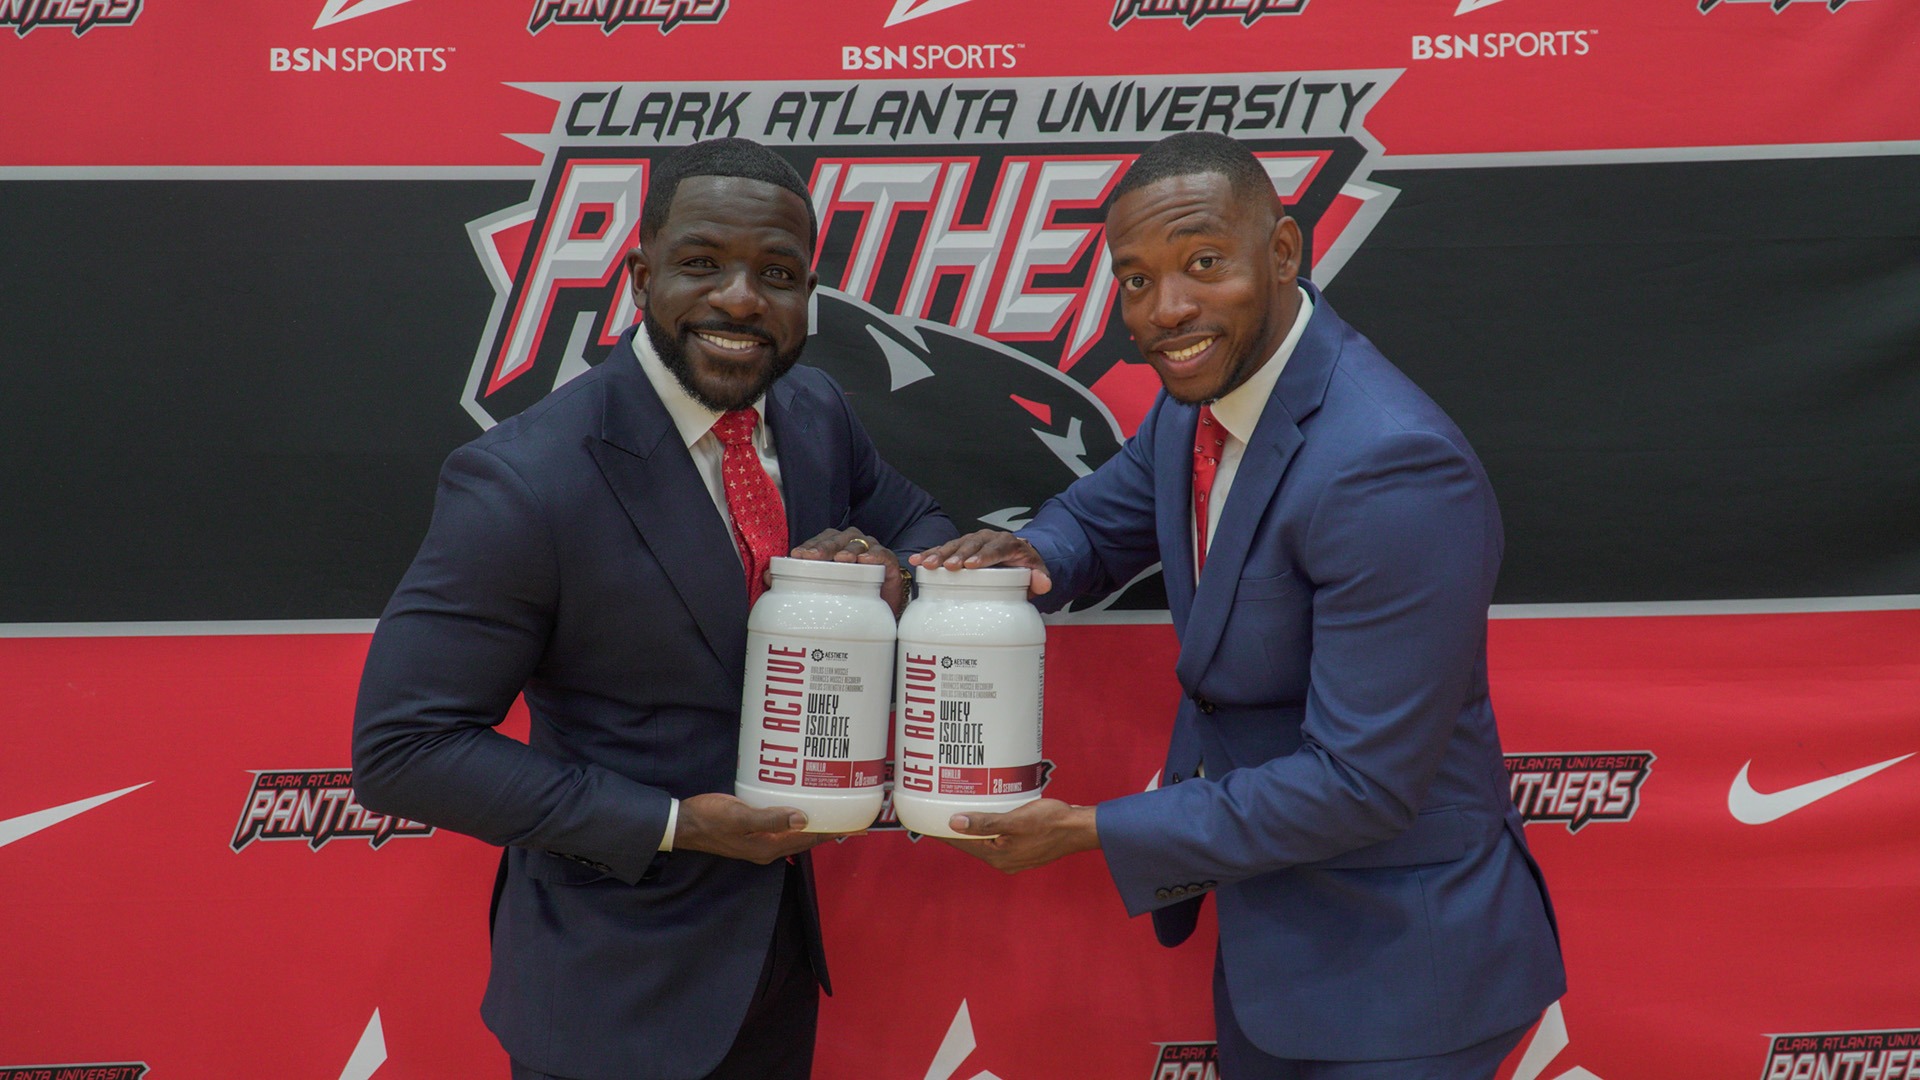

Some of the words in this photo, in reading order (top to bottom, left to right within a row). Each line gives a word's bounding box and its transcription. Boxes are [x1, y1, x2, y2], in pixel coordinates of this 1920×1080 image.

[841, 45, 908, 70] BSN
[1411, 33, 1479, 60] BSN
[270, 47, 337, 72] BSN
[564, 85, 752, 143] CLARK
[763, 83, 1018, 142] ATLANTA
[1037, 76, 1377, 136] UNIVERSITY
[762, 644, 807, 734] ACTIVE
[904, 652, 936, 741] ACTIVE
[807, 693, 839, 715] WHEY
[940, 700, 970, 722] WHEY
[805, 714, 850, 737] ISOLATE
[939, 721, 983, 744] ISOLATE
[803, 736, 850, 759] PROTEIN
[938, 743, 984, 766] PROTEIN
[758, 739, 799, 786] GET
[902, 746, 934, 793] GET
[1567, 756, 1647, 769] UNIVERSITY
[258, 775, 303, 787] CLARK
[307, 773, 352, 787] ATLAN
[992, 778, 1003, 794] 28
[1163, 1047, 1207, 1060] CLARK
[1776, 1038, 1818, 1050] CLARK
[1823, 1036, 1883, 1049] ATLANTA
